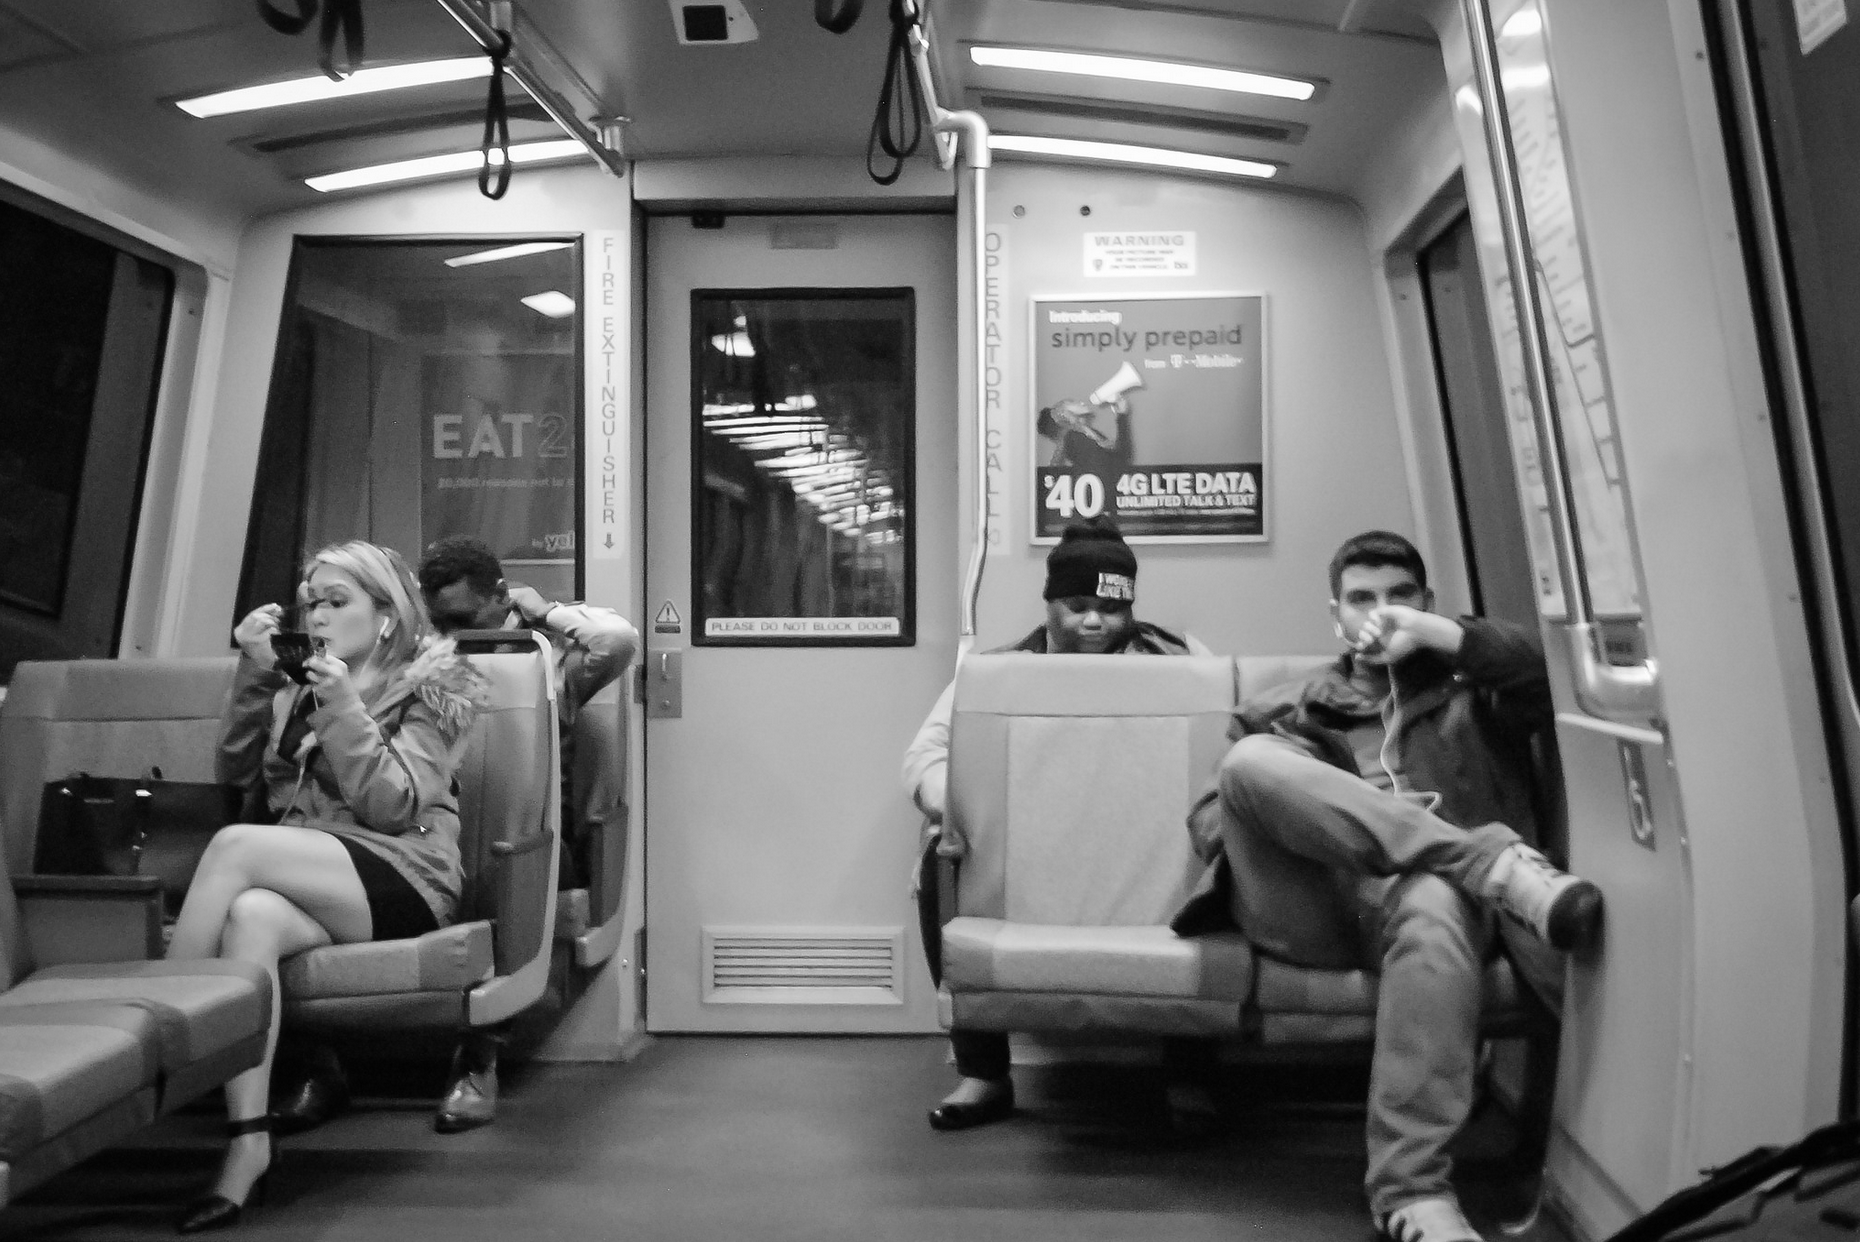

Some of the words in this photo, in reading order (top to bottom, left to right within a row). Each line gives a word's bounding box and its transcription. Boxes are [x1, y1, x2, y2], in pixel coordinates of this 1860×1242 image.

[1094, 235, 1184, 247] WARNING
[602, 237, 614, 306] FIRE
[985, 232, 1001, 409] OPERATOR
[1049, 310, 1122, 325] Introducing
[1051, 328, 1137, 352] simply
[1145, 325, 1243, 351] prepaid
[433, 412, 575, 460] EAT2
[602, 316, 616, 524] EXTINGUISHER
[985, 429, 1001, 518] CALL
[1116, 473, 1149, 496] 4G
[1151, 472, 1193, 495] LTE
[1195, 472, 1256, 495] DATA
[1044, 473, 1105, 519] $40
[1116, 495, 1181, 509] UNLIMITED
[1184, 495, 1214, 508] TALK
[1226, 494, 1256, 507] TEXT
[711, 622, 755, 632] PLEASE
[761, 622, 778, 632] DO
[783, 622, 808, 632] NOT
[813, 622, 853, 632] BLOCK
[857, 622, 892, 632] DOOR
